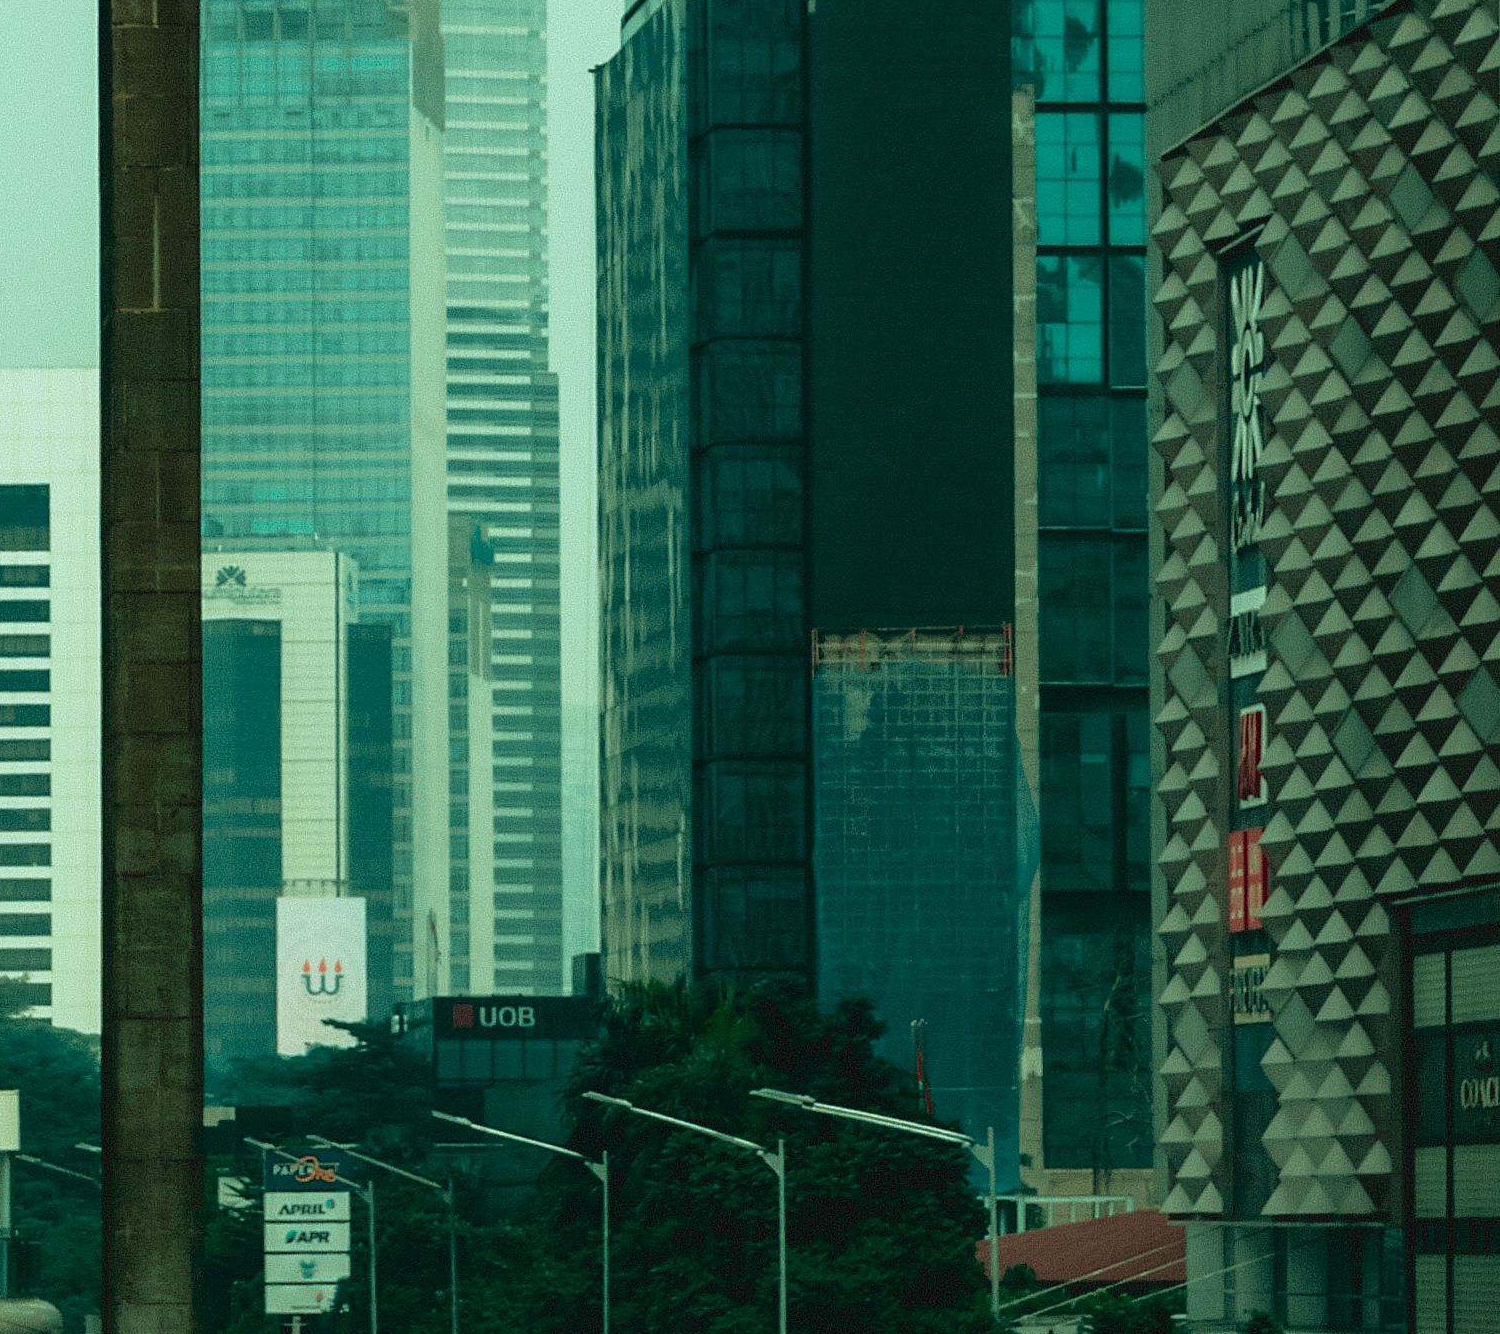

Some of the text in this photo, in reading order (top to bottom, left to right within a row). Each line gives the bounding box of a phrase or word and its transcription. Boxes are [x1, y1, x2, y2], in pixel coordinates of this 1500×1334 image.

[479, 1006, 535, 1027] UOB
[278, 1203, 325, 1215] APRIL
[296, 1231, 330, 1243] APR
